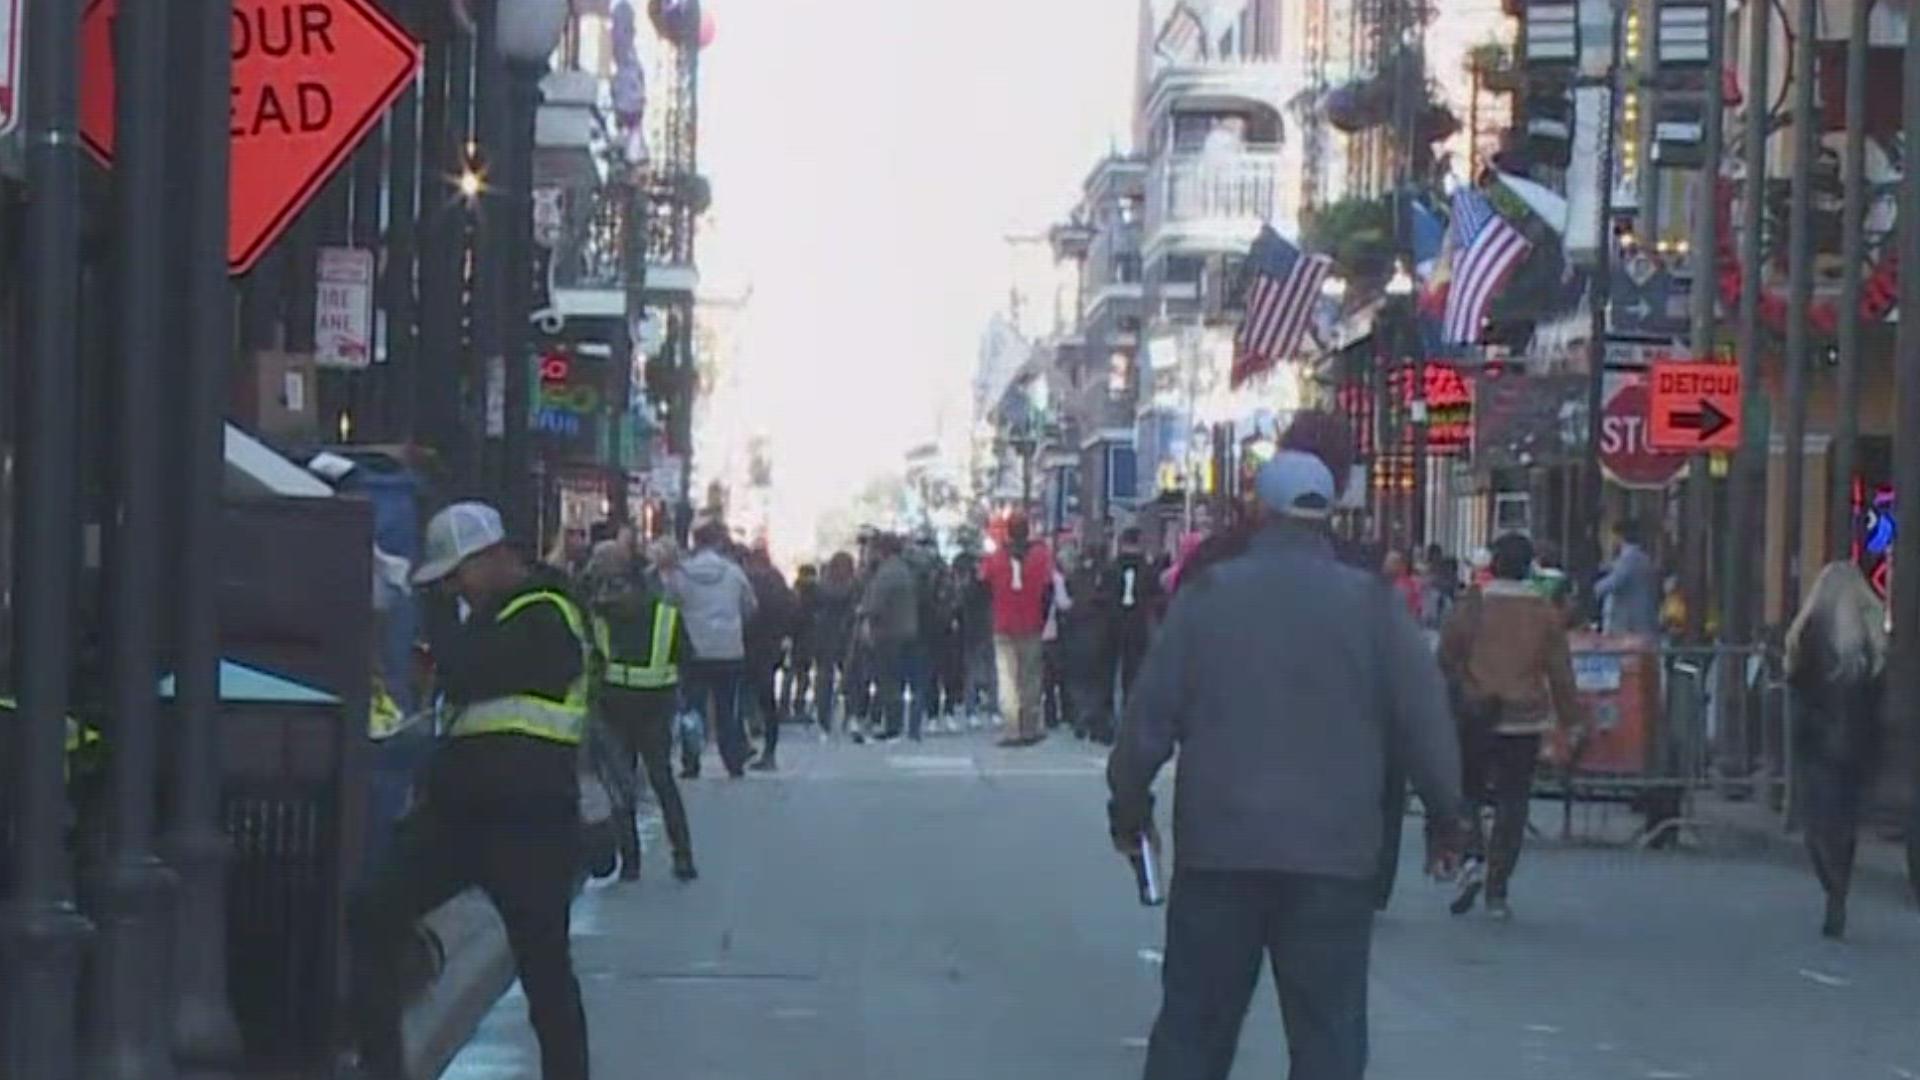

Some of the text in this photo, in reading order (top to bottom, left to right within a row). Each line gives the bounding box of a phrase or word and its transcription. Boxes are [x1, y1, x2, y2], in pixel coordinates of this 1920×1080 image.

[1659, 373, 1739, 395] DETOU
[1600, 416, 1656, 454] ST
[1010, 557, 1023, 591] 1
[1122, 567, 1135, 606] 1
